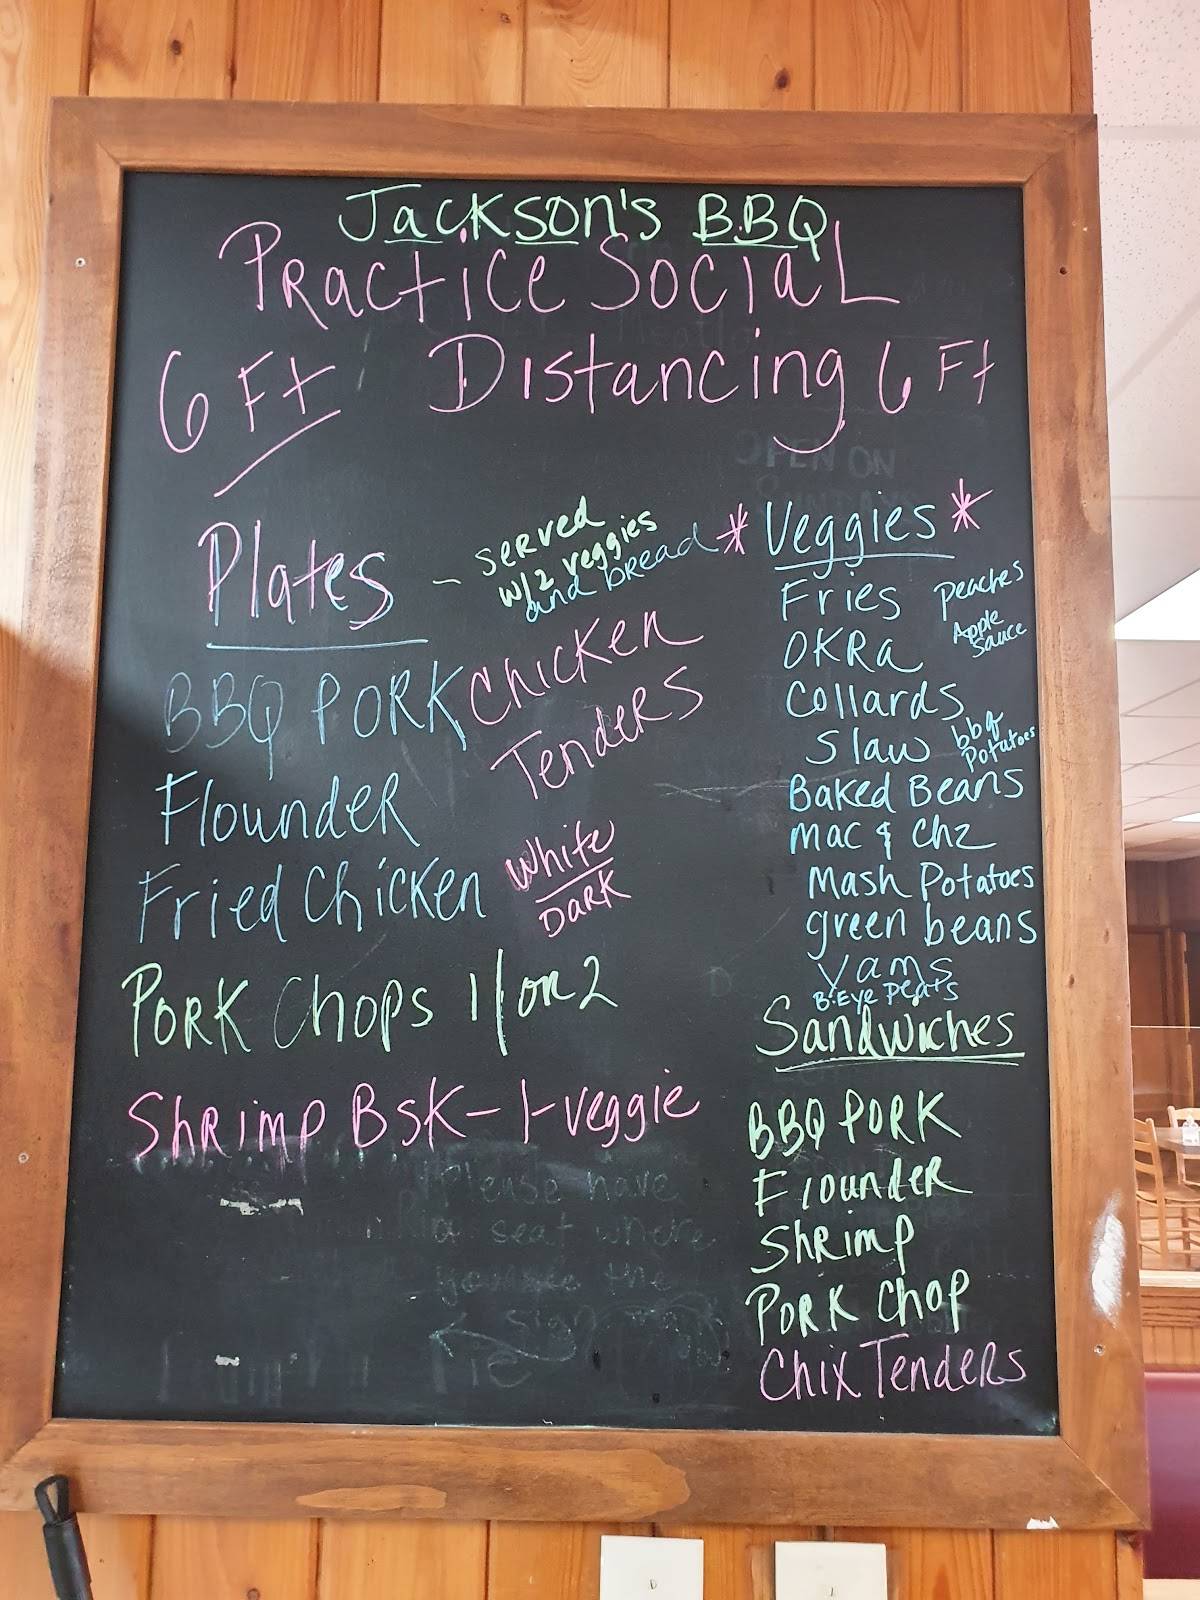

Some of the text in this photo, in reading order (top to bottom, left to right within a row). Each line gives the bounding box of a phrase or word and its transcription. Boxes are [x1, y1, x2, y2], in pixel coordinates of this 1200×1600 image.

[693, 193, 828, 262] BBQ
[159, 350, 209, 453] 6
[238, 350, 336, 433] Ft
[428, 328, 847, 454] Distancing
[937, 338, 997, 406] Ft
[561, 509, 658, 577] veggies
[765, 499, 937, 581] Veggies
[197, 518, 395, 631] Plates
[524, 573, 598, 624] and
[780, 570, 901, 622] Fries
[952, 608, 1005, 645] Apple
[163, 671, 285, 780] BBQ
[785, 679, 965, 721] Collards
[950, 709, 1005, 752] bbq
[788, 767, 1025, 814] Baked Beans
[504, 819, 616, 894] White
[807, 860, 1036, 902] Mash Potatoes
[138, 861, 288, 943] Fried
[804, 901, 1039, 961] green beans
[816, 953, 955, 999] Yams
[754, 994, 1016, 1059] Sandwiches
[747, 1097, 826, 1161] BBQ
